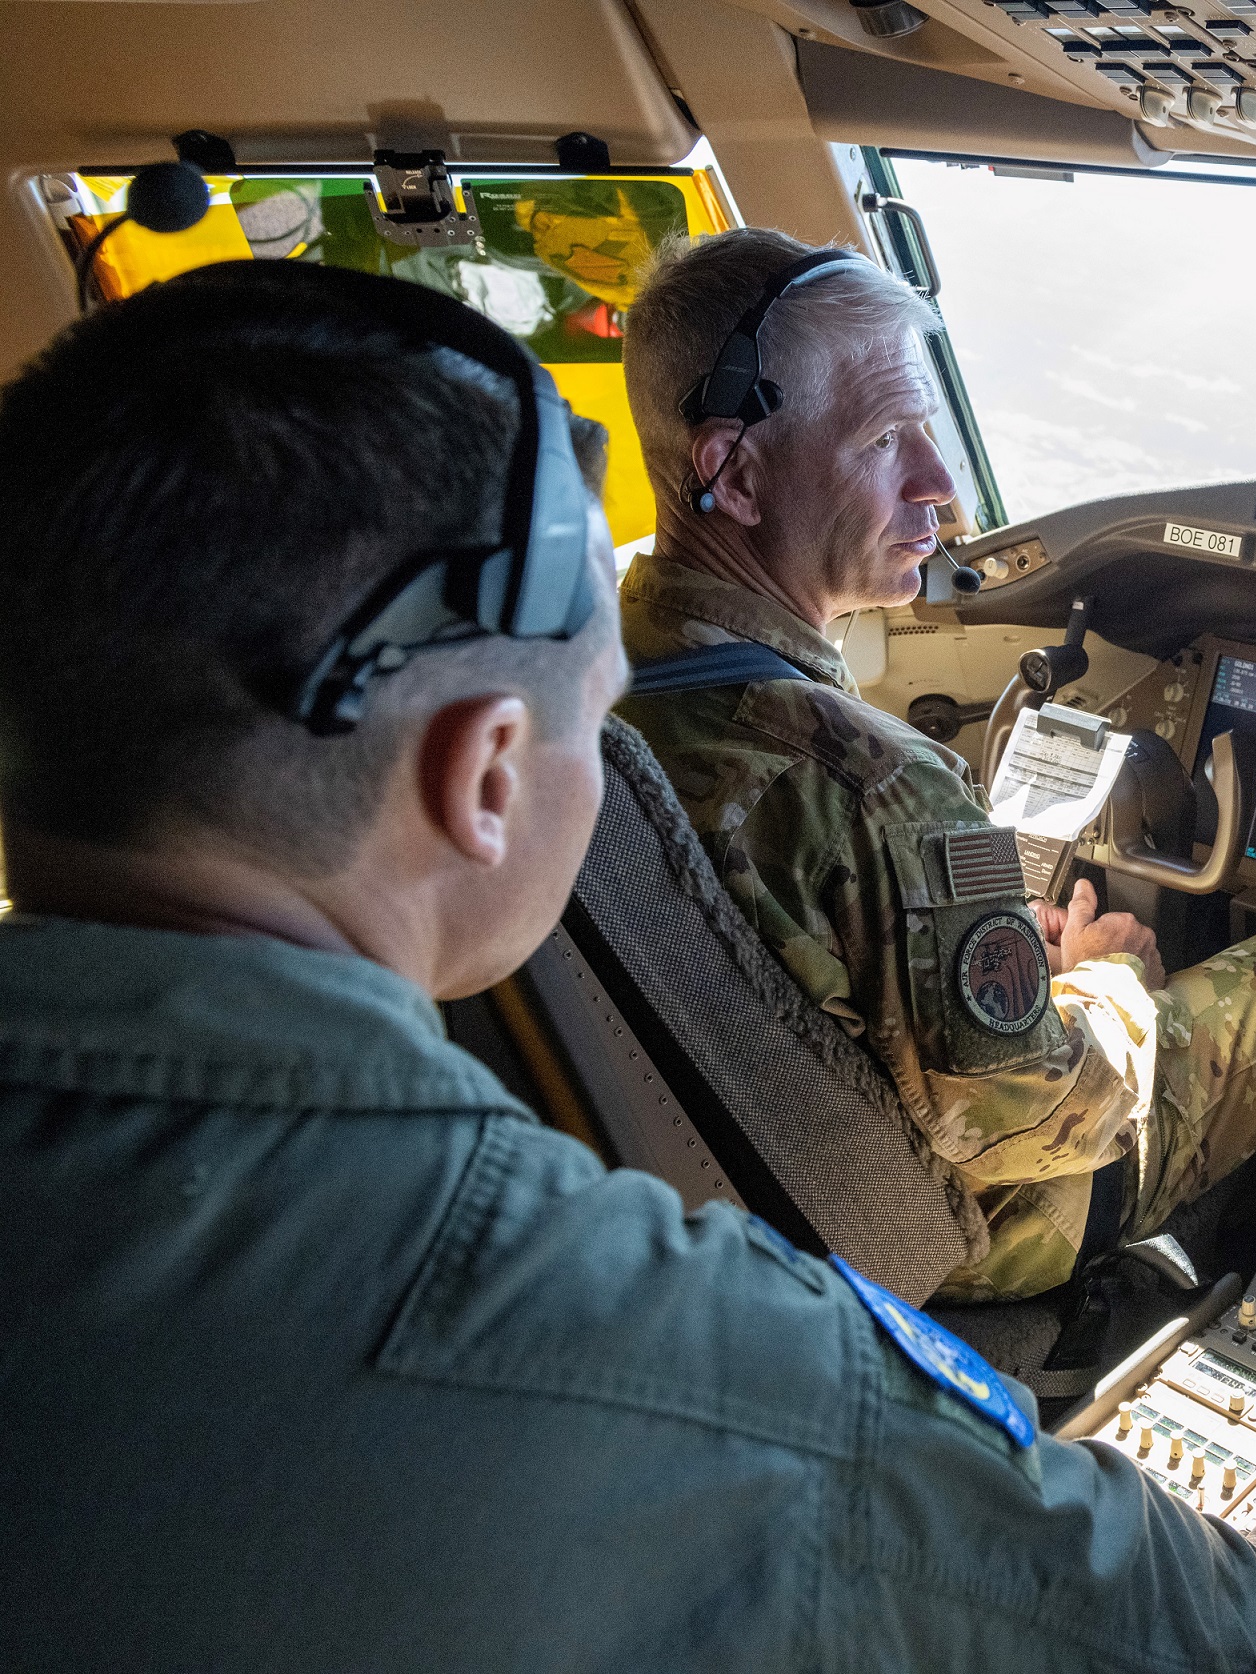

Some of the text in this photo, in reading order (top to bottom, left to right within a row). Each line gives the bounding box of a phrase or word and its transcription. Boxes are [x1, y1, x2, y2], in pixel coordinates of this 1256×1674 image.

[1170, 526, 1234, 553] BOE 081
[976, 916, 1004, 939] DISTRICT
[963, 940, 978, 966] FORCE
[1016, 922, 1046, 968] WASHINGTON
[962, 970, 970, 988] AIR
[988, 1004, 1042, 1031] HEADQUARTERS
